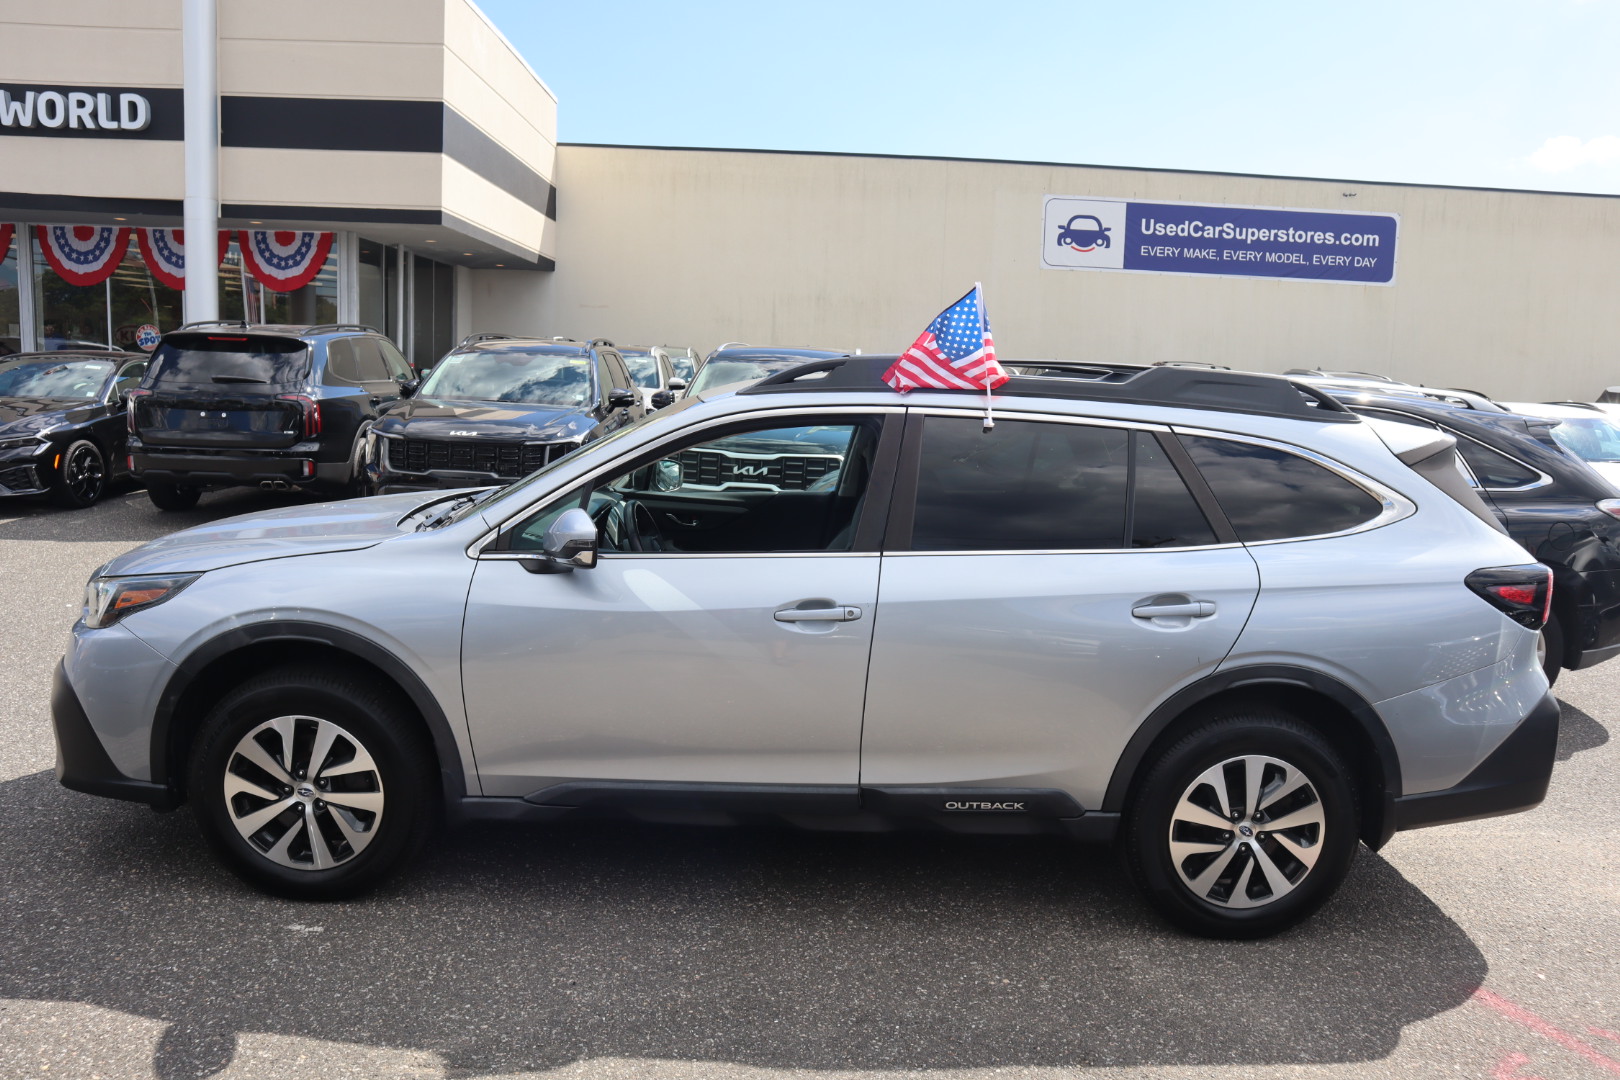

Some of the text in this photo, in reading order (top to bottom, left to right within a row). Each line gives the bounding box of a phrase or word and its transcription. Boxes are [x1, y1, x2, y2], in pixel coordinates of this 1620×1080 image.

[0, 89, 151, 131] WORLD
[1141, 218, 1380, 247] UsedCarSuperstores.com
[1140, 245, 1378, 268] EVERY MAKE, EVERY MODEL, EVERY DAY
[139, 335, 160, 346] SPOT
[733, 464, 768, 476] KIA
[945, 801, 1024, 810] OUTBACK
